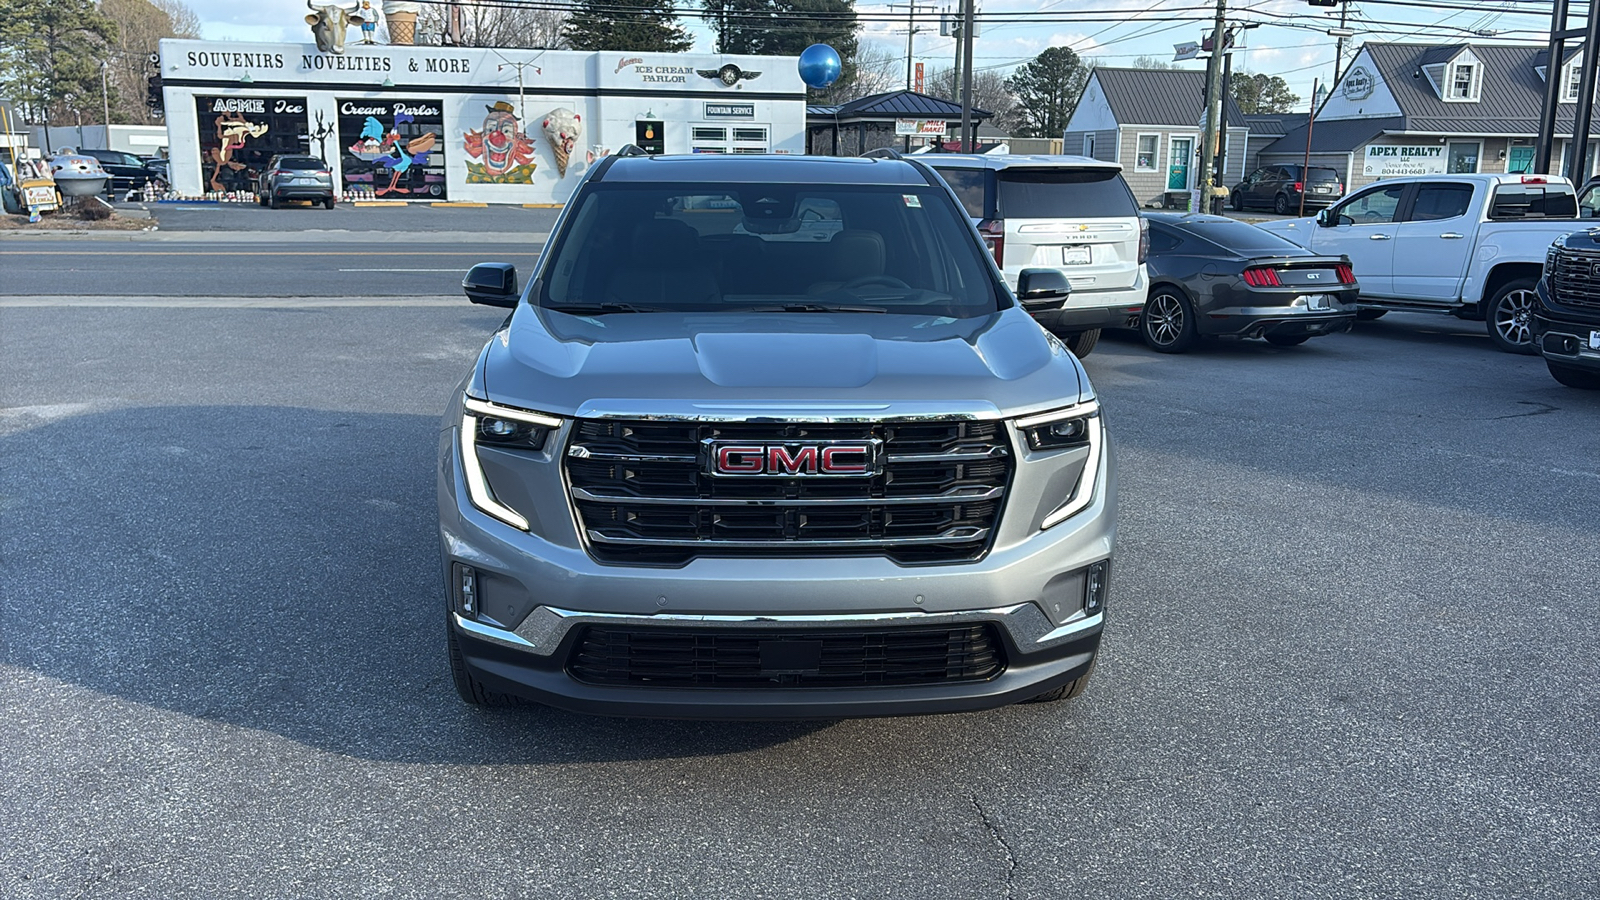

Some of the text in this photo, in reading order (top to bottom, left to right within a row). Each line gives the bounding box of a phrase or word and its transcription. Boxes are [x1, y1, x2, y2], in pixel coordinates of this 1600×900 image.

[187, 51, 470, 73] SOUVENIRS NOVELTIES & MORE
[635, 65, 694, 75] ICE CREAM
[643, 75, 687, 83] PARLOR
[213, 98, 304, 114] ACME Ice
[340, 102, 440, 116] Cream Parlor
[707, 106, 753, 115] FOUNTAIN SERVICE
[1370, 147, 1442, 157] APEX REALTY
[718, 445, 868, 475] GMC
